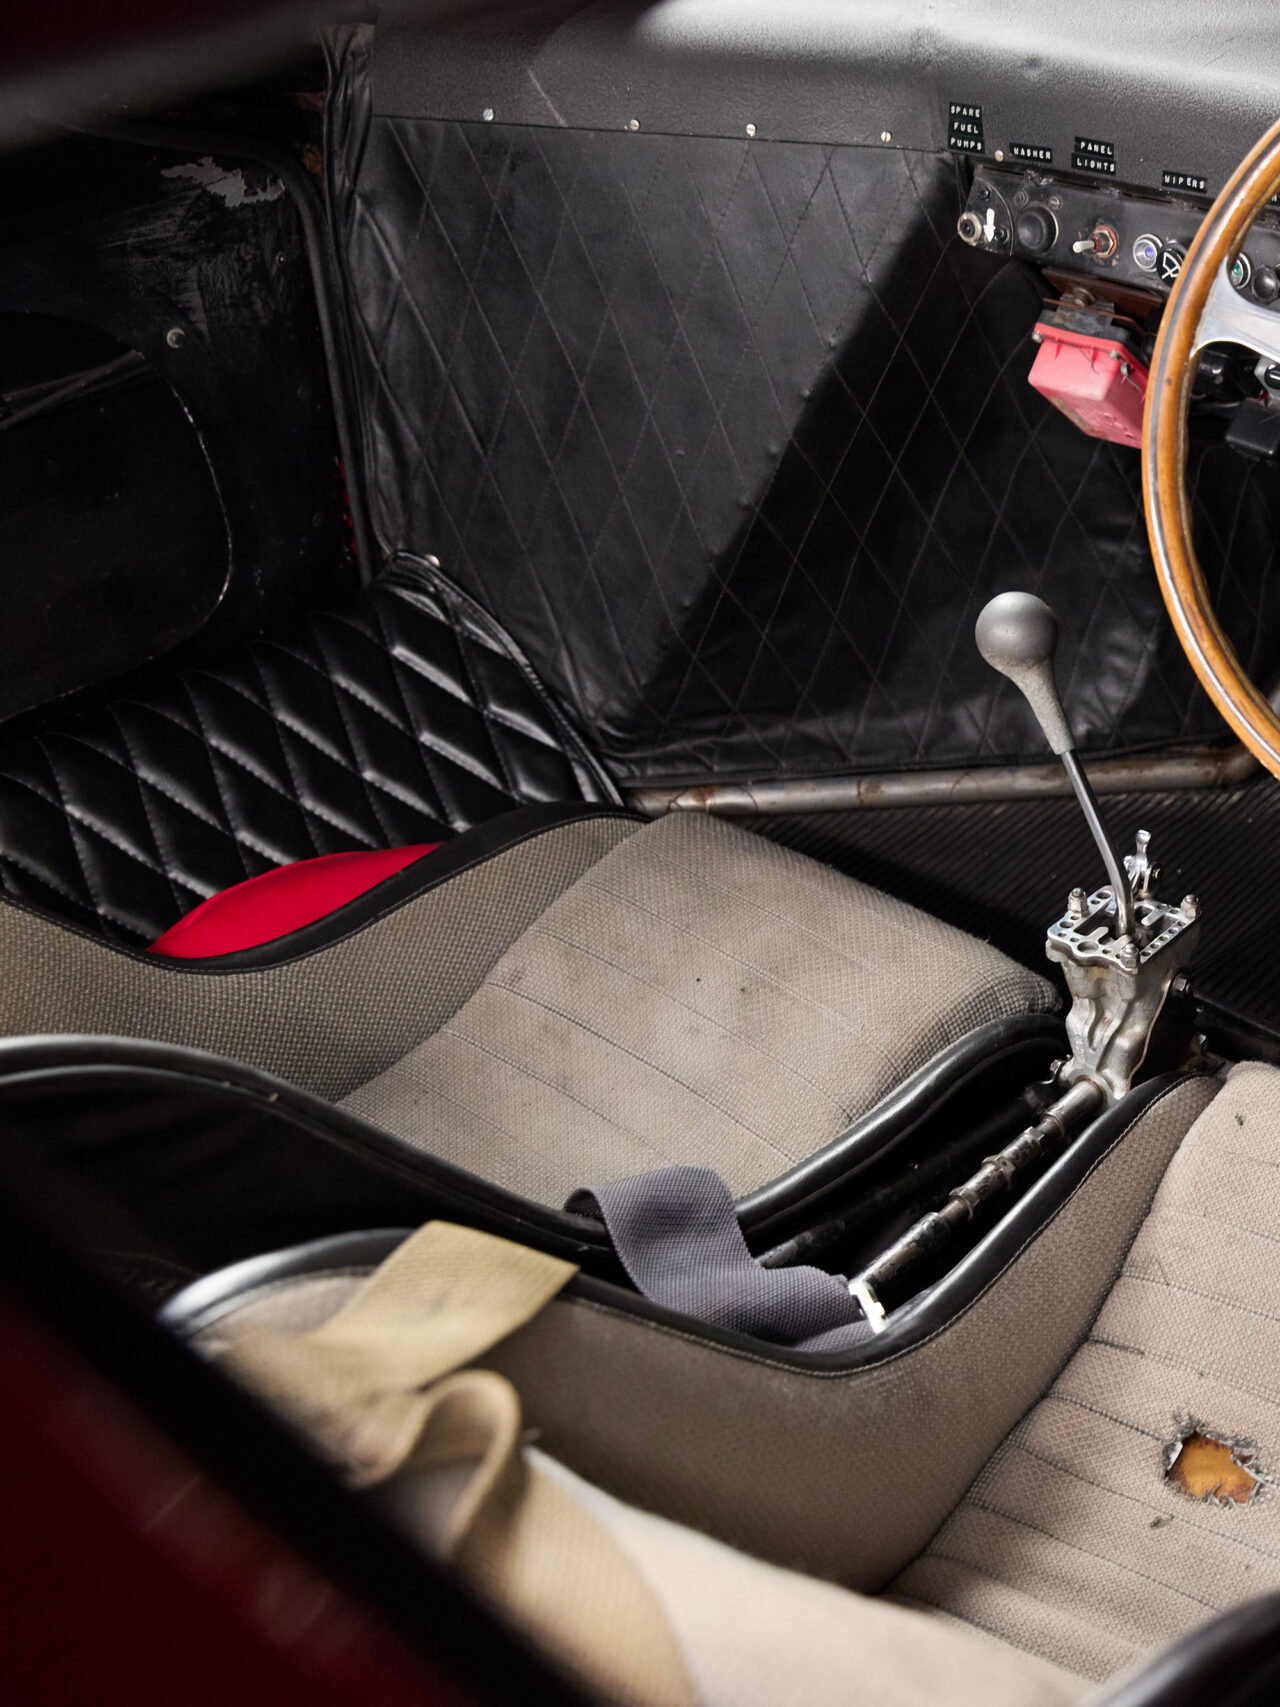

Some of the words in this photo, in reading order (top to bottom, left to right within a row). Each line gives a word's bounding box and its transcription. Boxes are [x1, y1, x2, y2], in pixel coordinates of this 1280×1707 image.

[950, 104, 981, 119] SPARE
[953, 121, 979, 135] FUEL
[950, 137, 983, 151] PUMPS
[1080, 140, 1113, 156] PANEL
[1013, 146, 1052, 160] WASHER
[1076, 157, 1116, 172] LIGHTS
[1164, 174, 1205, 190] WIPERS
